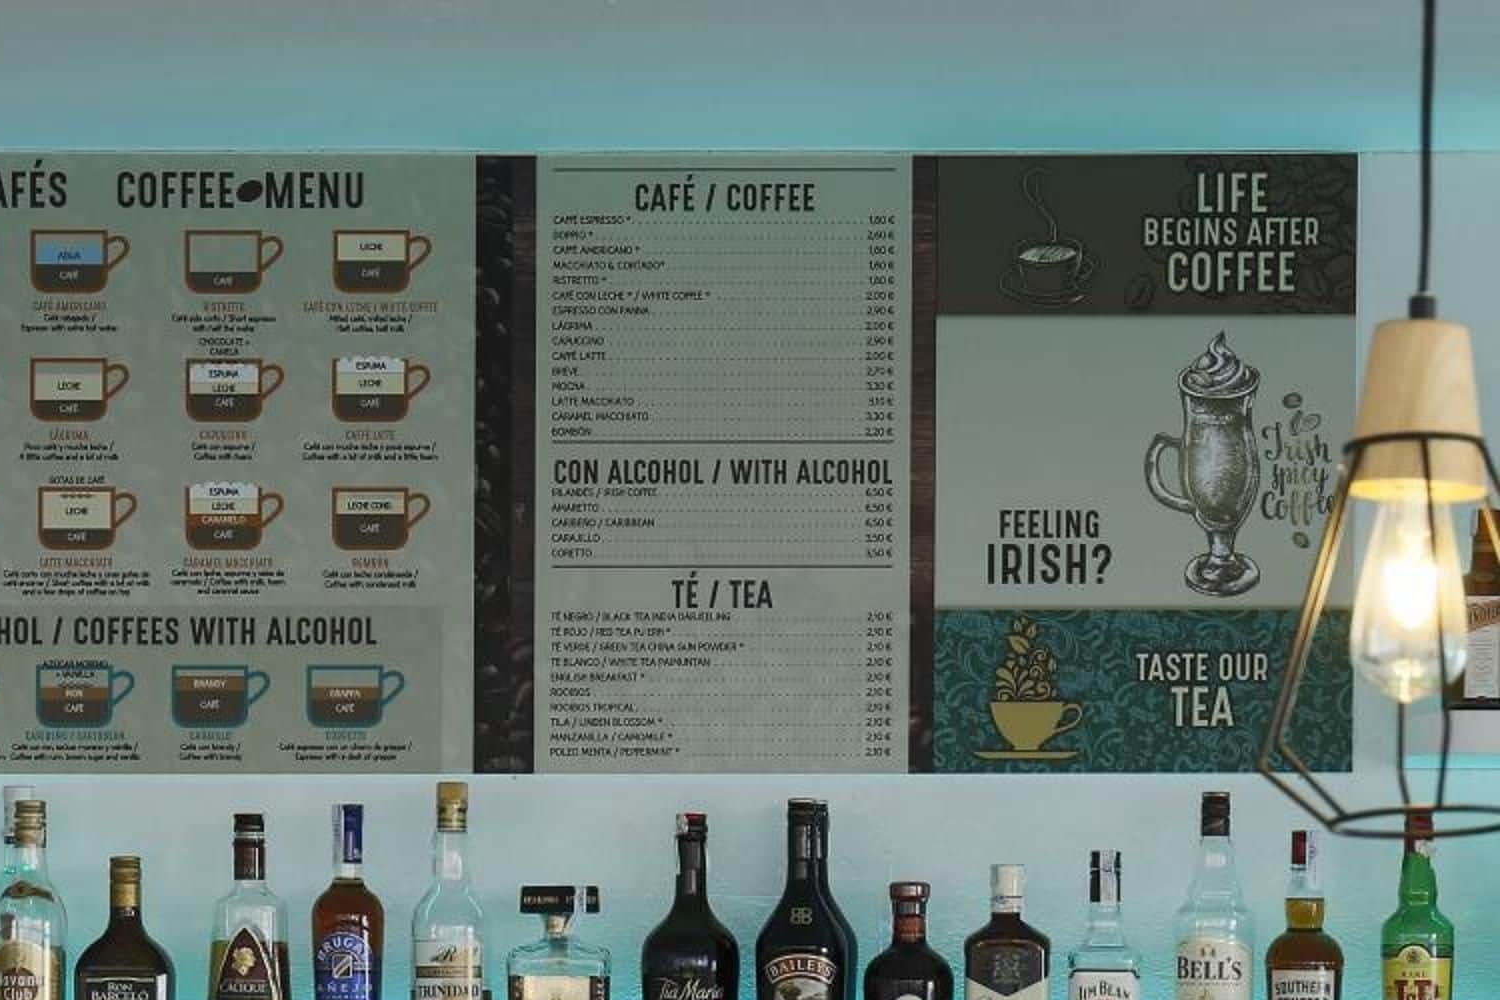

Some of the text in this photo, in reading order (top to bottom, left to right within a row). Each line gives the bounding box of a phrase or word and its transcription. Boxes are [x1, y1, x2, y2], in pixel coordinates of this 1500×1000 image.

[116, 171, 365, 208] COFFEE MENU
[635, 174, 695, 213] CAFÉ
[726, 183, 815, 212] COFFEE
[1197, 172, 1269, 213] LIFE
[1143, 217, 1320, 246] BEGINS AFTER
[1167, 251, 1296, 293] COFFEE
[553, 459, 599, 485] CON
[607, 459, 705, 485] ALCOHOL
[729, 459, 787, 485] WITH
[796, 459, 893, 485] ALCOHOL
[998, 509, 1100, 539] FEELING
[986, 543, 1113, 586] IRISH?
[671, 571, 699, 609] TÉ
[729, 580, 772, 609] TEA
[73, 616, 180, 647] COFFEES
[189, 616, 257, 647] WITH
[265, 616, 378, 647] ALCOHOL
[1136, 653, 1269, 682] TASTE OUR
[1171, 686, 1235, 728] TEA
[768, 959, 833, 978] BAILEYS
[1176, 955, 1243, 981] BELL'S
[3, 985, 33, 1000] Club
